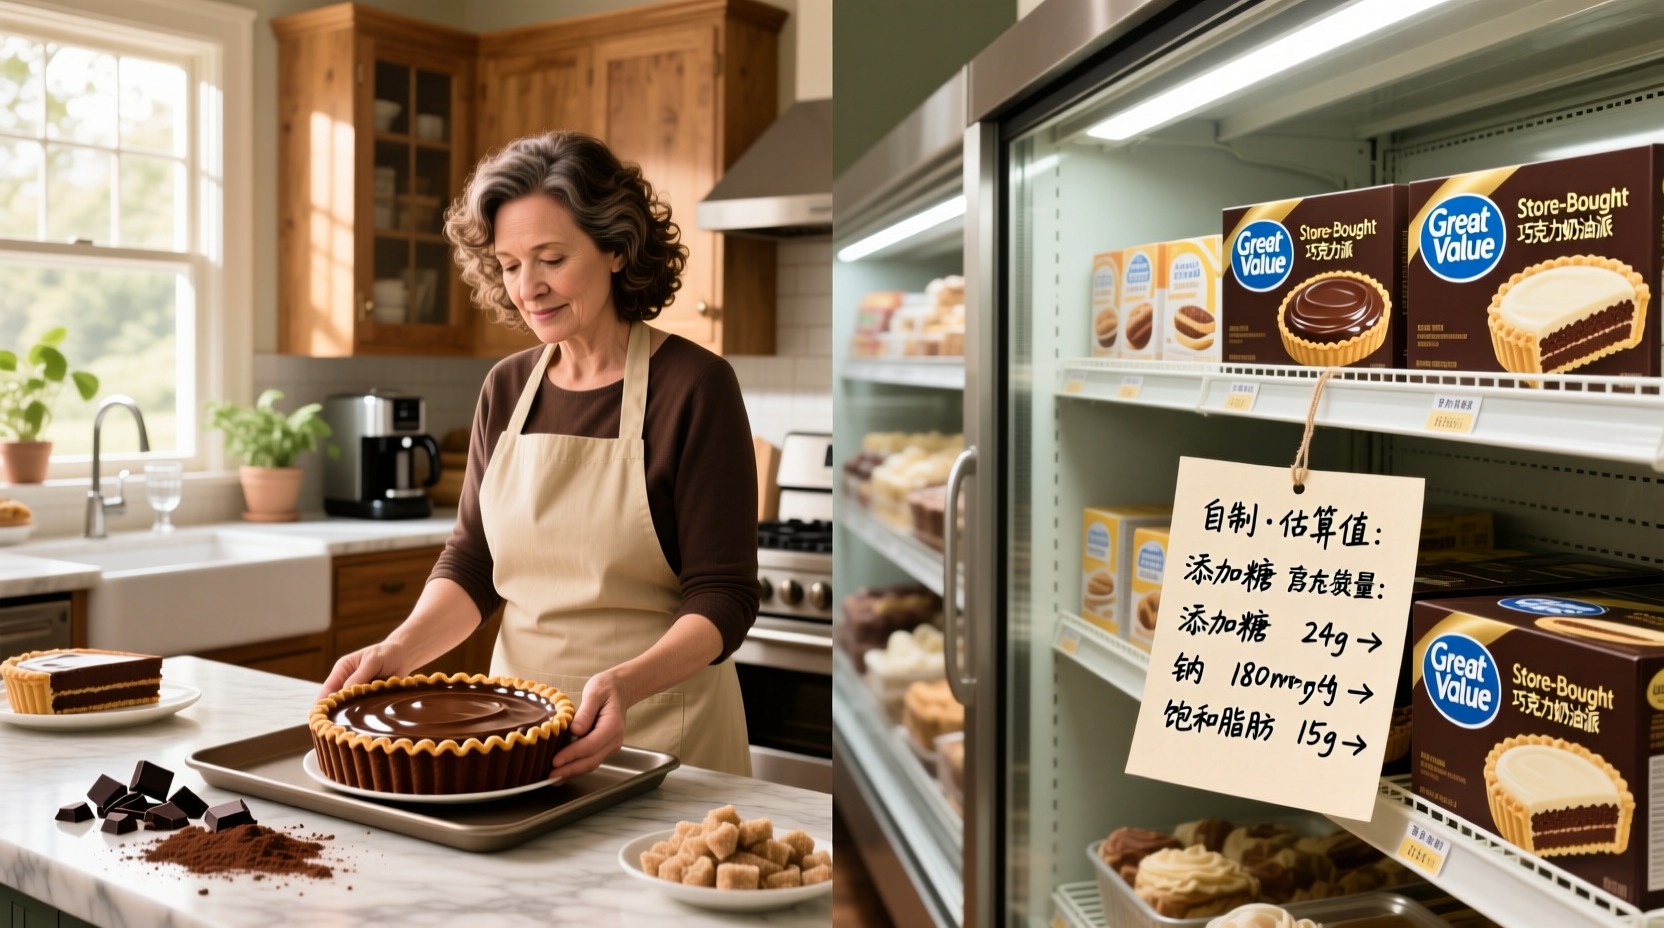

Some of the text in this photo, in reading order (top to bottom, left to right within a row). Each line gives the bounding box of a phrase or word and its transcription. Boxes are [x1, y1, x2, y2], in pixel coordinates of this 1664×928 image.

[1517, 187, 1629, 218] Store-Bought
[1428, 206, 1489, 236] Great
[1517, 214, 1613, 244] 巧克力奶油派
[1237, 230, 1284, 255] Great
[1305, 240, 1353, 260] 巧克力派
[1432, 234, 1495, 264] Value
[1240, 254, 1286, 276] Value
[1184, 554, 1277, 593] 添加糖
[1178, 604, 1348, 657] 添加糖 24g
[1172, 652, 1205, 685] 钠
[1431, 642, 1487, 682] Great
[1435, 671, 1492, 711] Value
[1512, 663, 1614, 711] Store-Bought
[1164, 699, 1337, 757] 饱和脂肪 15g
